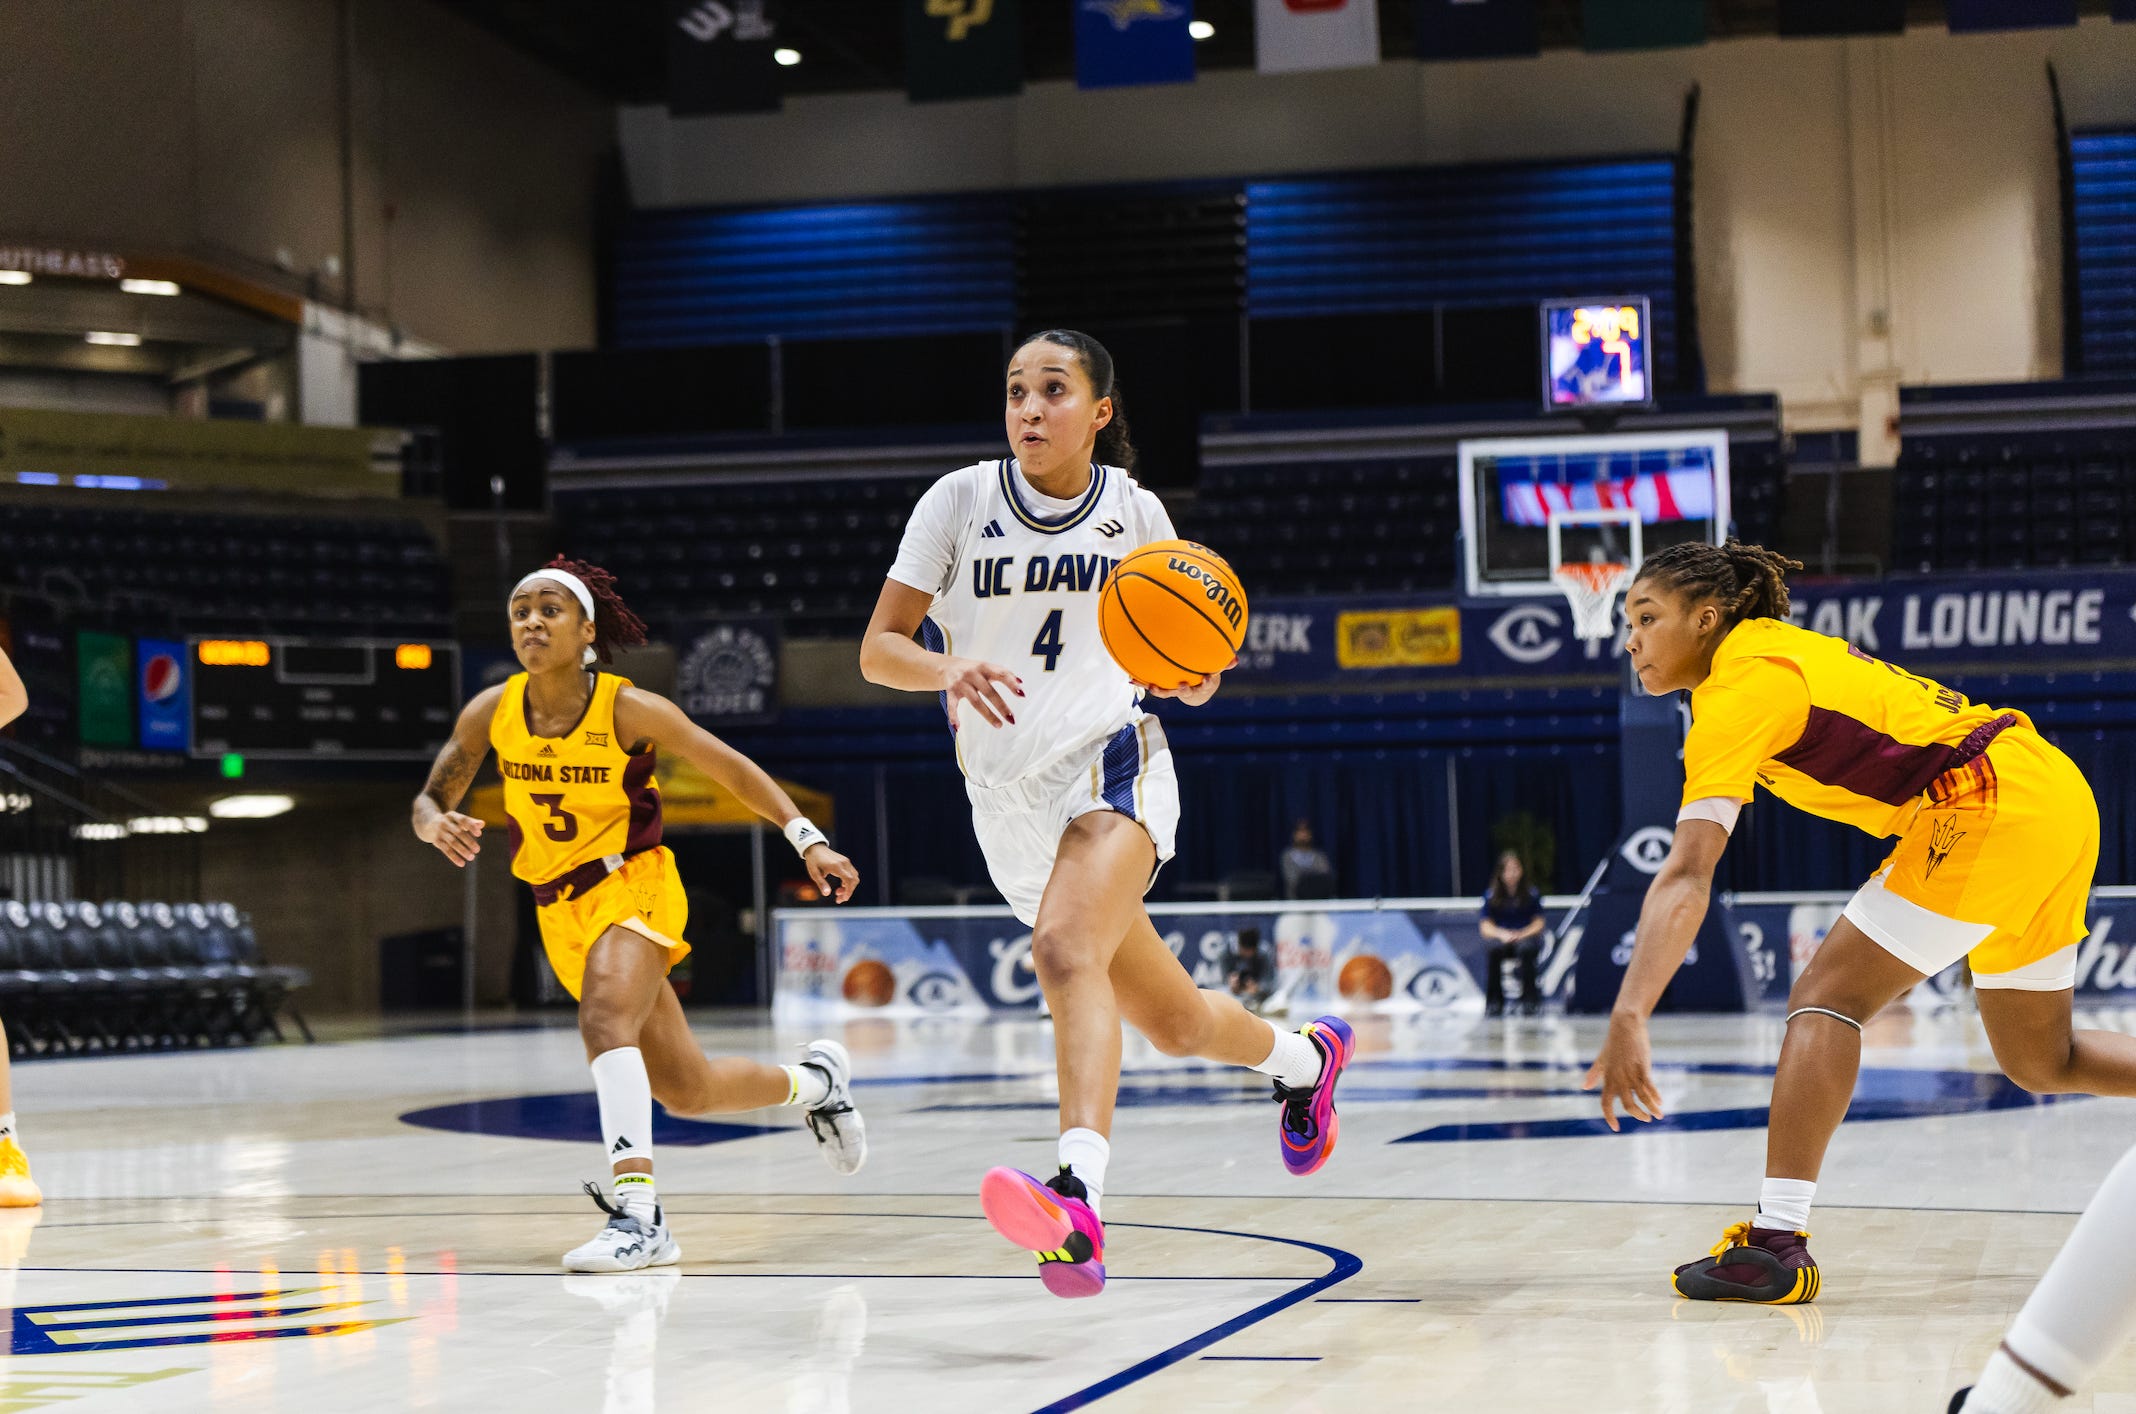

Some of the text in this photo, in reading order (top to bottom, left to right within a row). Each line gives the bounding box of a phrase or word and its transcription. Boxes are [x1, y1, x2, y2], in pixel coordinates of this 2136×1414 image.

[973, 553, 1121, 598] UC DAVI
[1168, 556, 1243, 632] Wilson
[1031, 608, 1065, 672] 4
[1904, 590, 2105, 650] LOUNGE
[1934, 685, 1963, 714] JAC
[560, 766, 611, 784] STATE
[529, 793, 578, 842] 3
